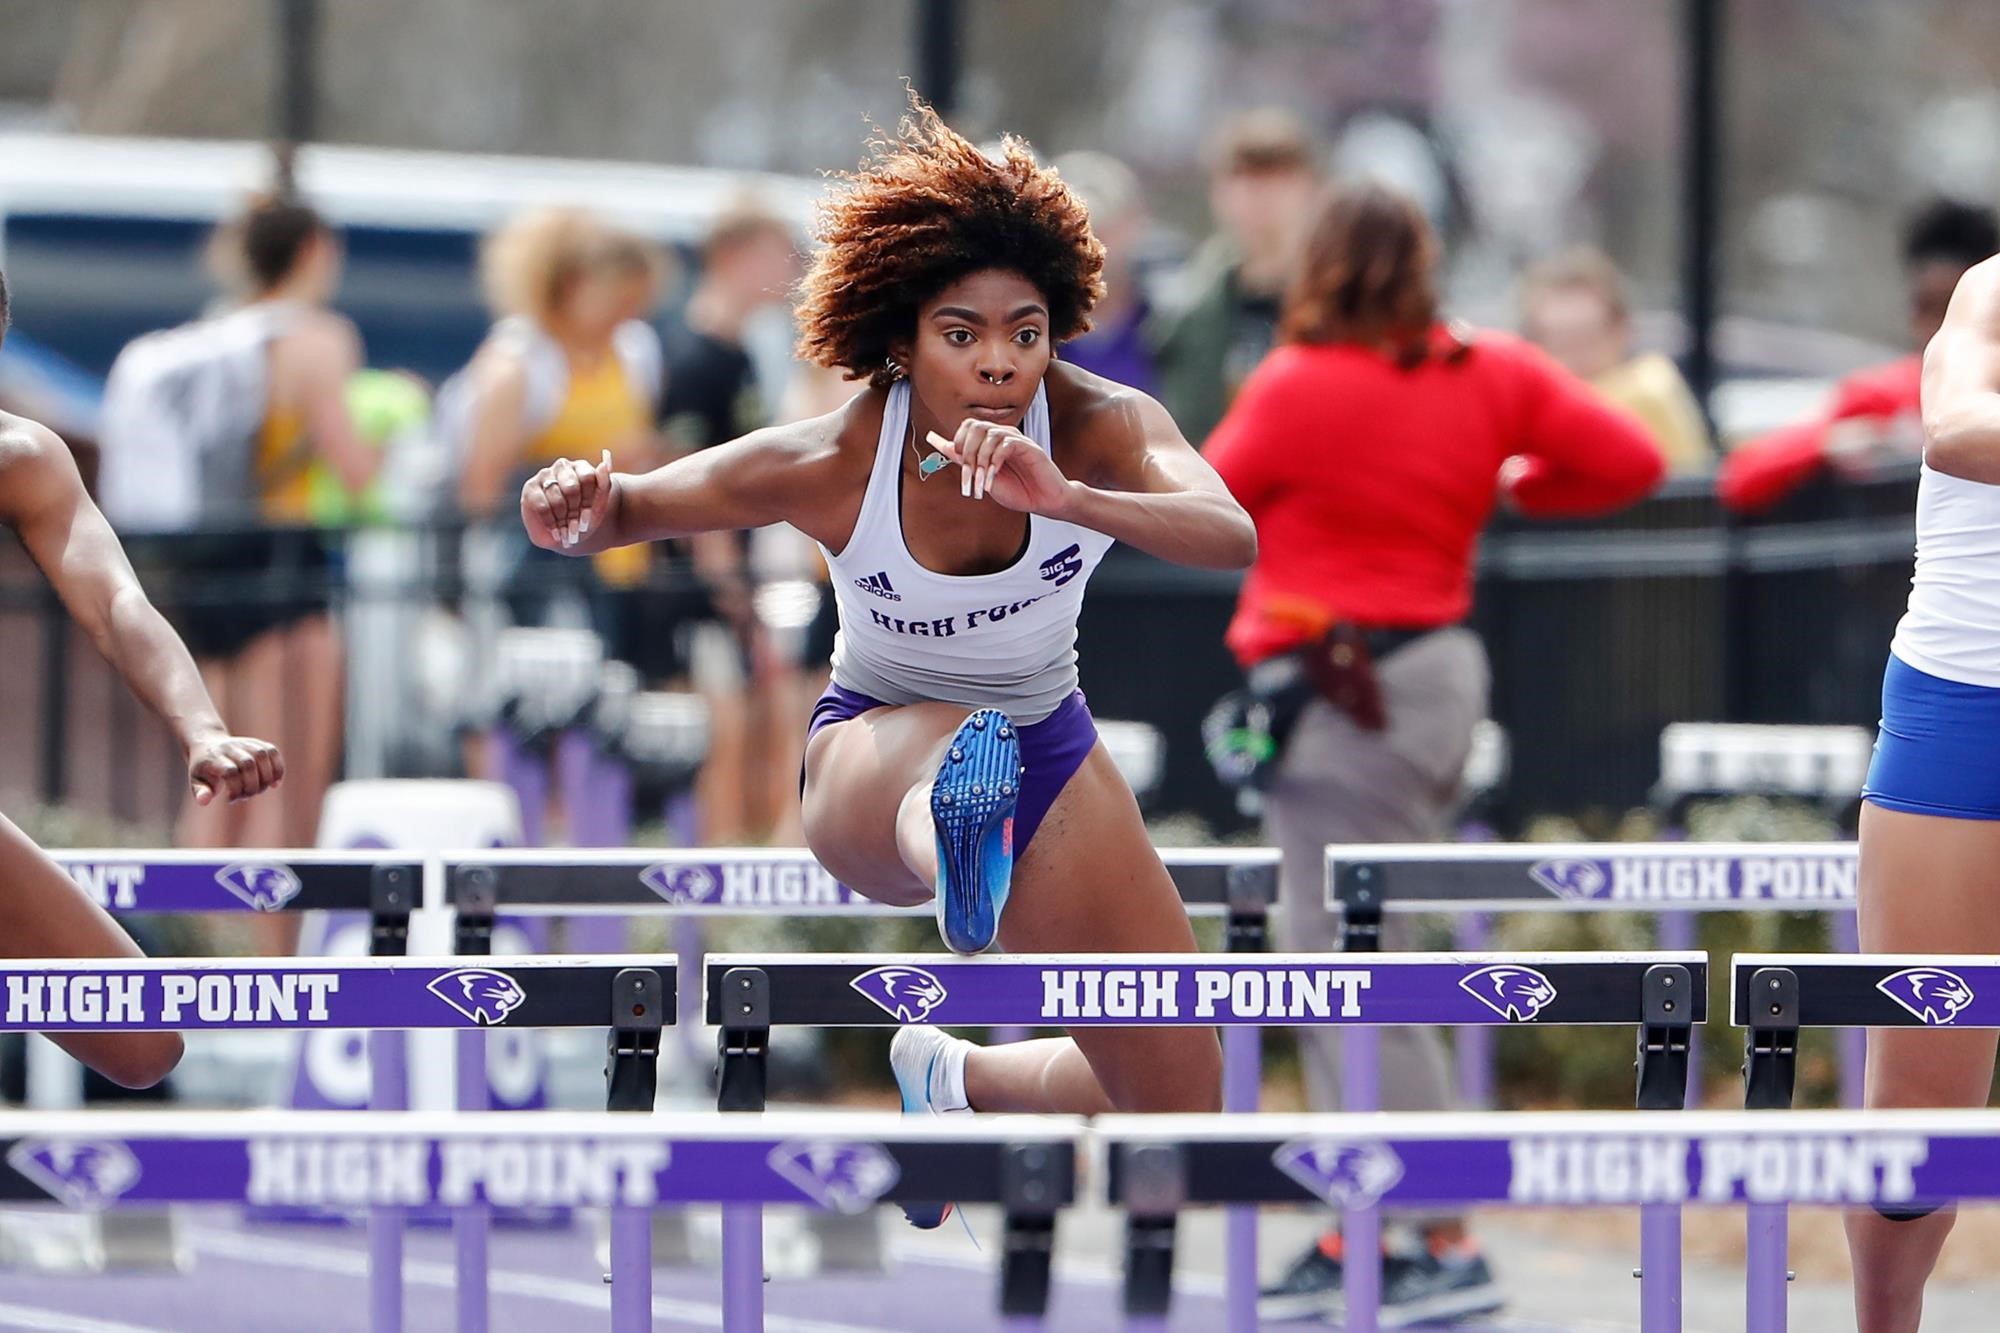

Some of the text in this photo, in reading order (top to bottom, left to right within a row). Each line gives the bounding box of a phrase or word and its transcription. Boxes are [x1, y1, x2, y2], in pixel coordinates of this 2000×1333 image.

[854, 579, 901, 601] adidas
[1040, 561, 1064, 578] BIG
[869, 608, 956, 637] HIGH
[721, 864, 841, 905] HIGH
[1612, 859, 1859, 899] HIGH POIN
[6, 974, 339, 1024] HIGH POINT
[1041, 970, 1371, 1018] HIGH POINT
[247, 1142, 670, 1204] HIGH POINT
[1510, 1139, 1928, 1200] HIGH POINT
